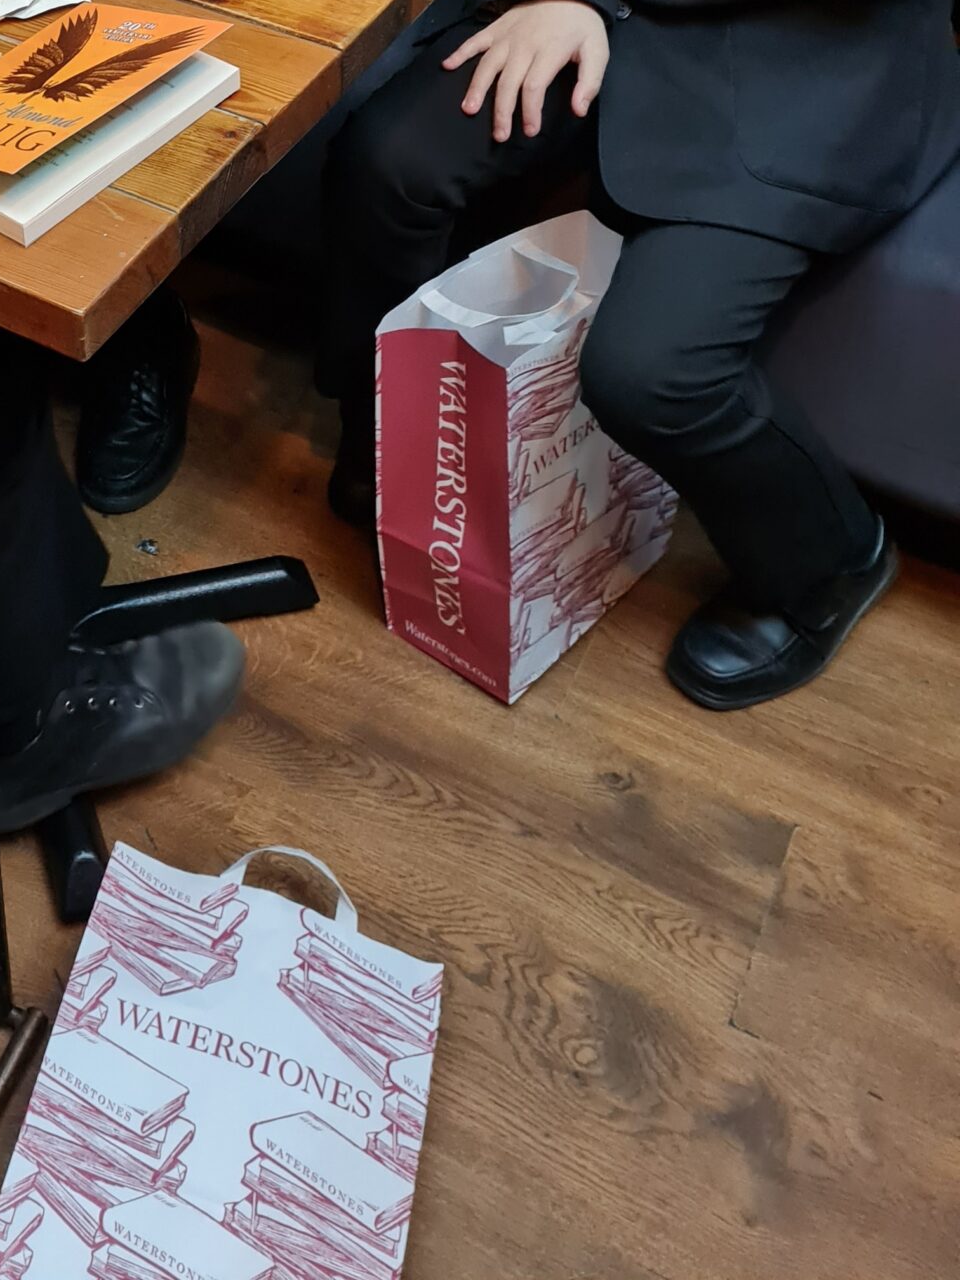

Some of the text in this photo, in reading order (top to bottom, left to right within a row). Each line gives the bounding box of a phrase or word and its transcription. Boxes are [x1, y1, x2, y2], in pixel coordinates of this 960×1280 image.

[431, 359, 468, 636] WATERSTONES
[403, 619, 497, 688] Waterstones.com
[313, 922, 403, 989] WATERSTONES
[116, 998, 374, 1120] WATERSTONES
[265, 1138, 365, 1216] WATERSTONES
[114, 1220, 206, 1280] WATERSTON
